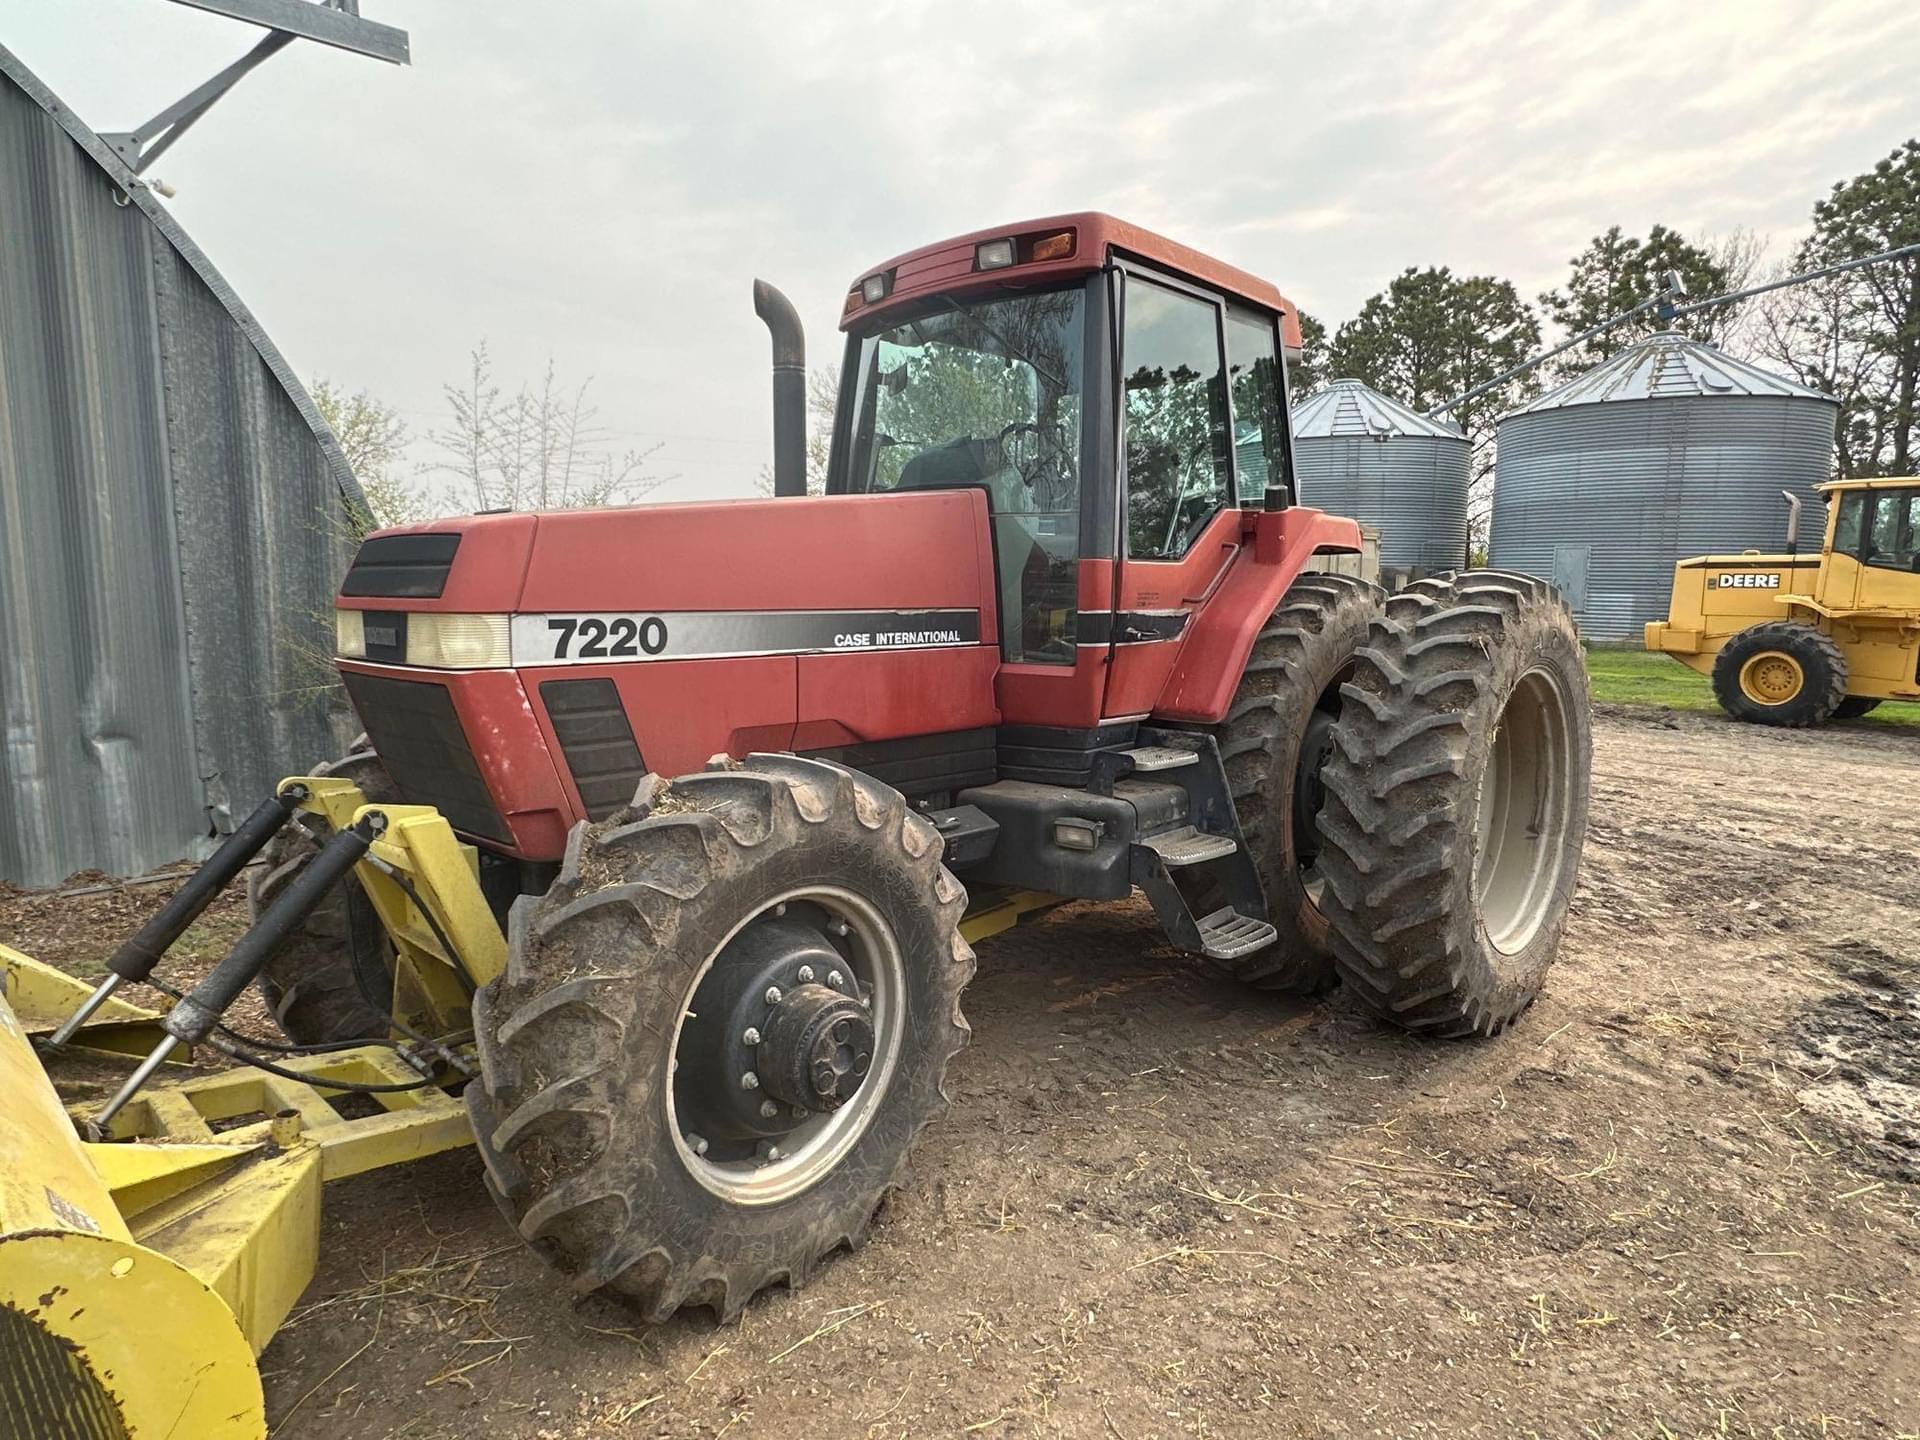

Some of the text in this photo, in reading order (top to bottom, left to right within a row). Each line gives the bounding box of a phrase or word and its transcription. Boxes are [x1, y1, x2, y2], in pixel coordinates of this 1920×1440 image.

[1719, 574, 1780, 588] DEERE
[548, 617, 668, 659] 7220
[834, 630, 960, 647] CASE INTERNATIONAL
